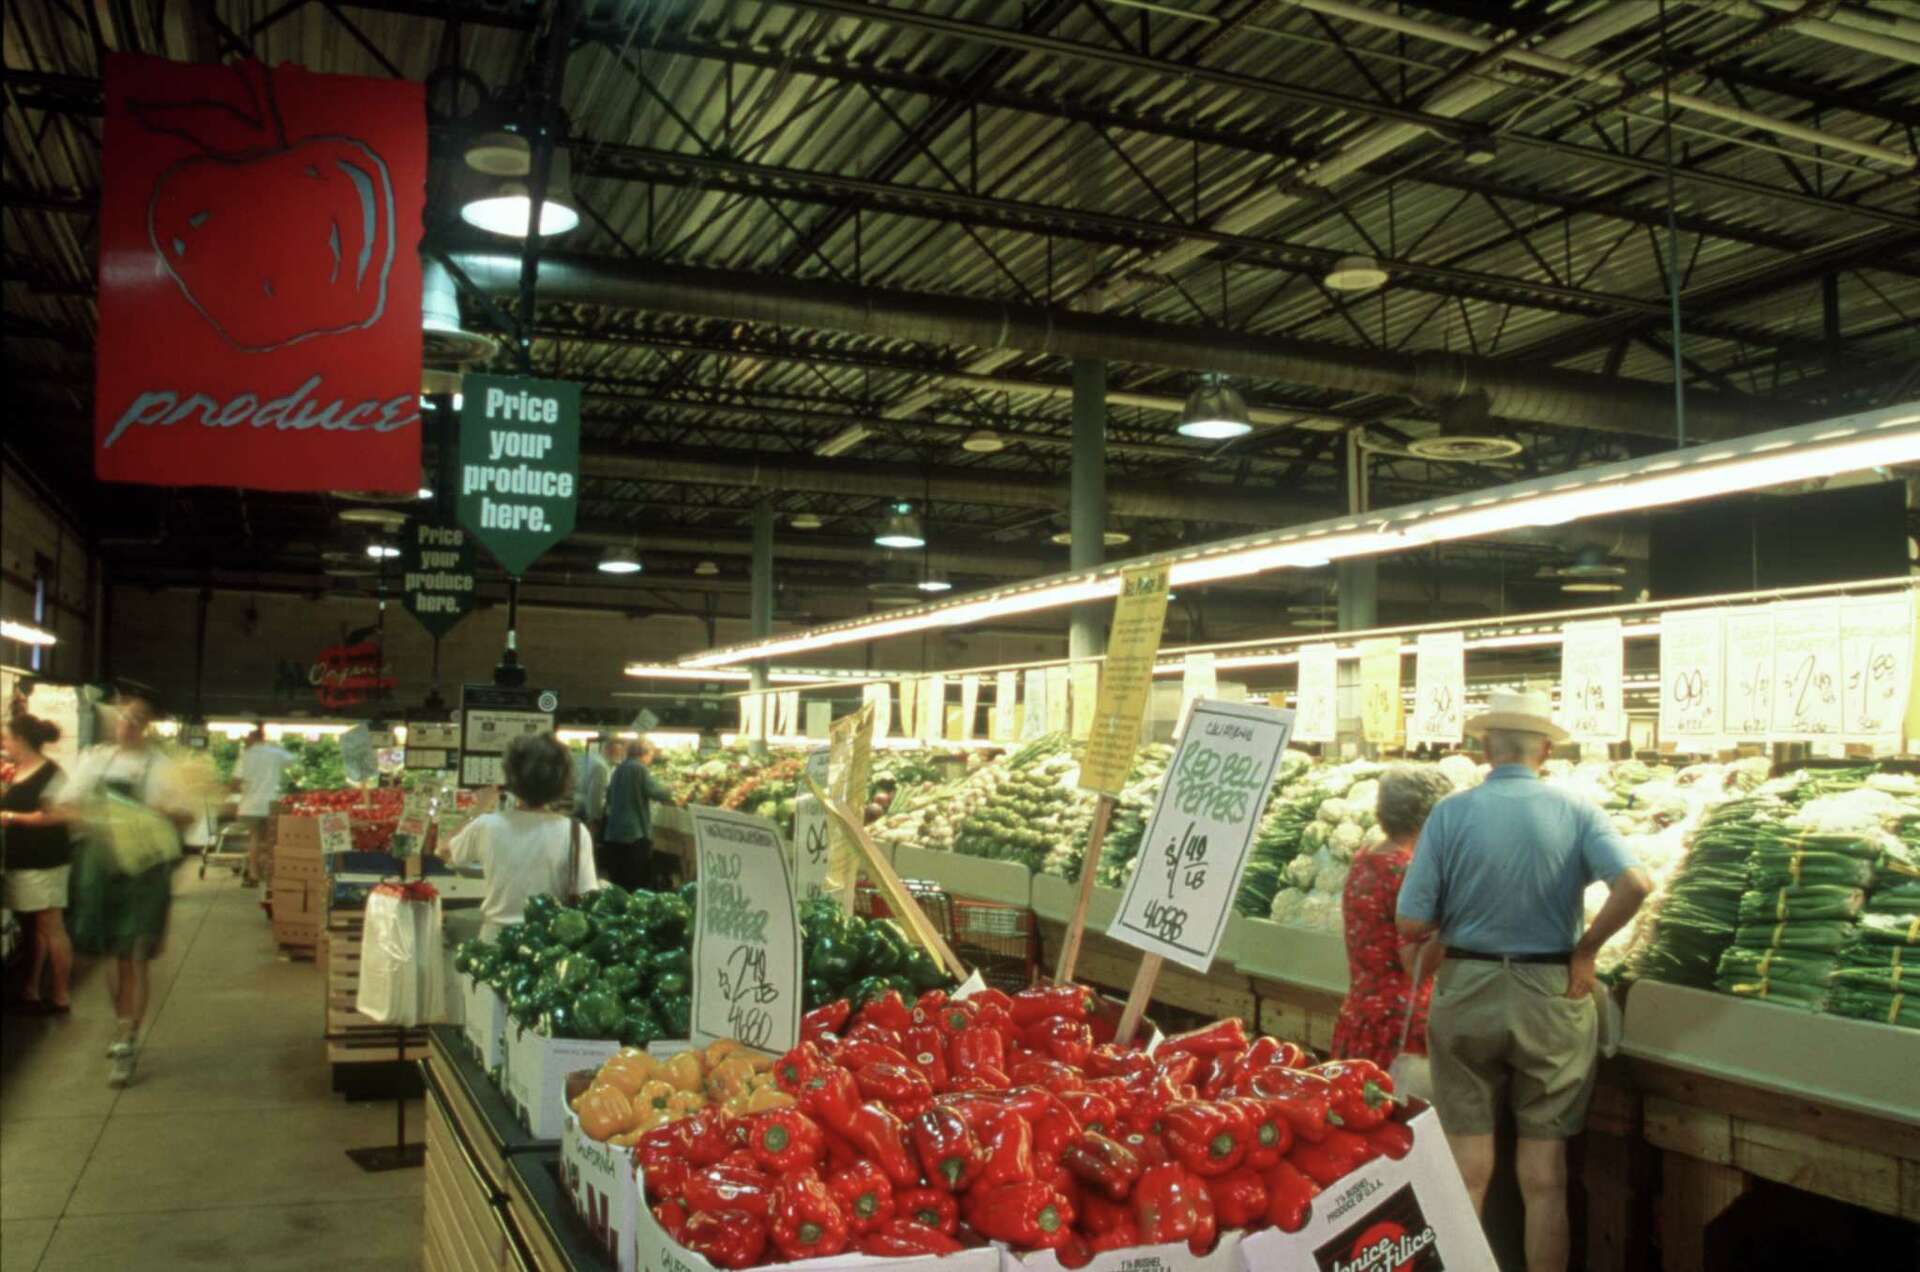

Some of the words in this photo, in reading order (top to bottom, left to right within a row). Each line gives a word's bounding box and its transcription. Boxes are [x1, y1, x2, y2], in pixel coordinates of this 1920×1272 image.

[103, 375, 420, 448] produce
[486, 388, 559, 424] Price
[488, 430, 553, 460] your
[463, 464, 574, 498] produce
[480, 497, 552, 532] here.
[418, 525, 464, 546] Price
[421, 550, 460, 570] your
[405, 571, 473, 592] produce
[415, 592, 460, 613] here.
[1178, 741, 1220, 781] RED
[1219, 752, 1262, 789] BELL
